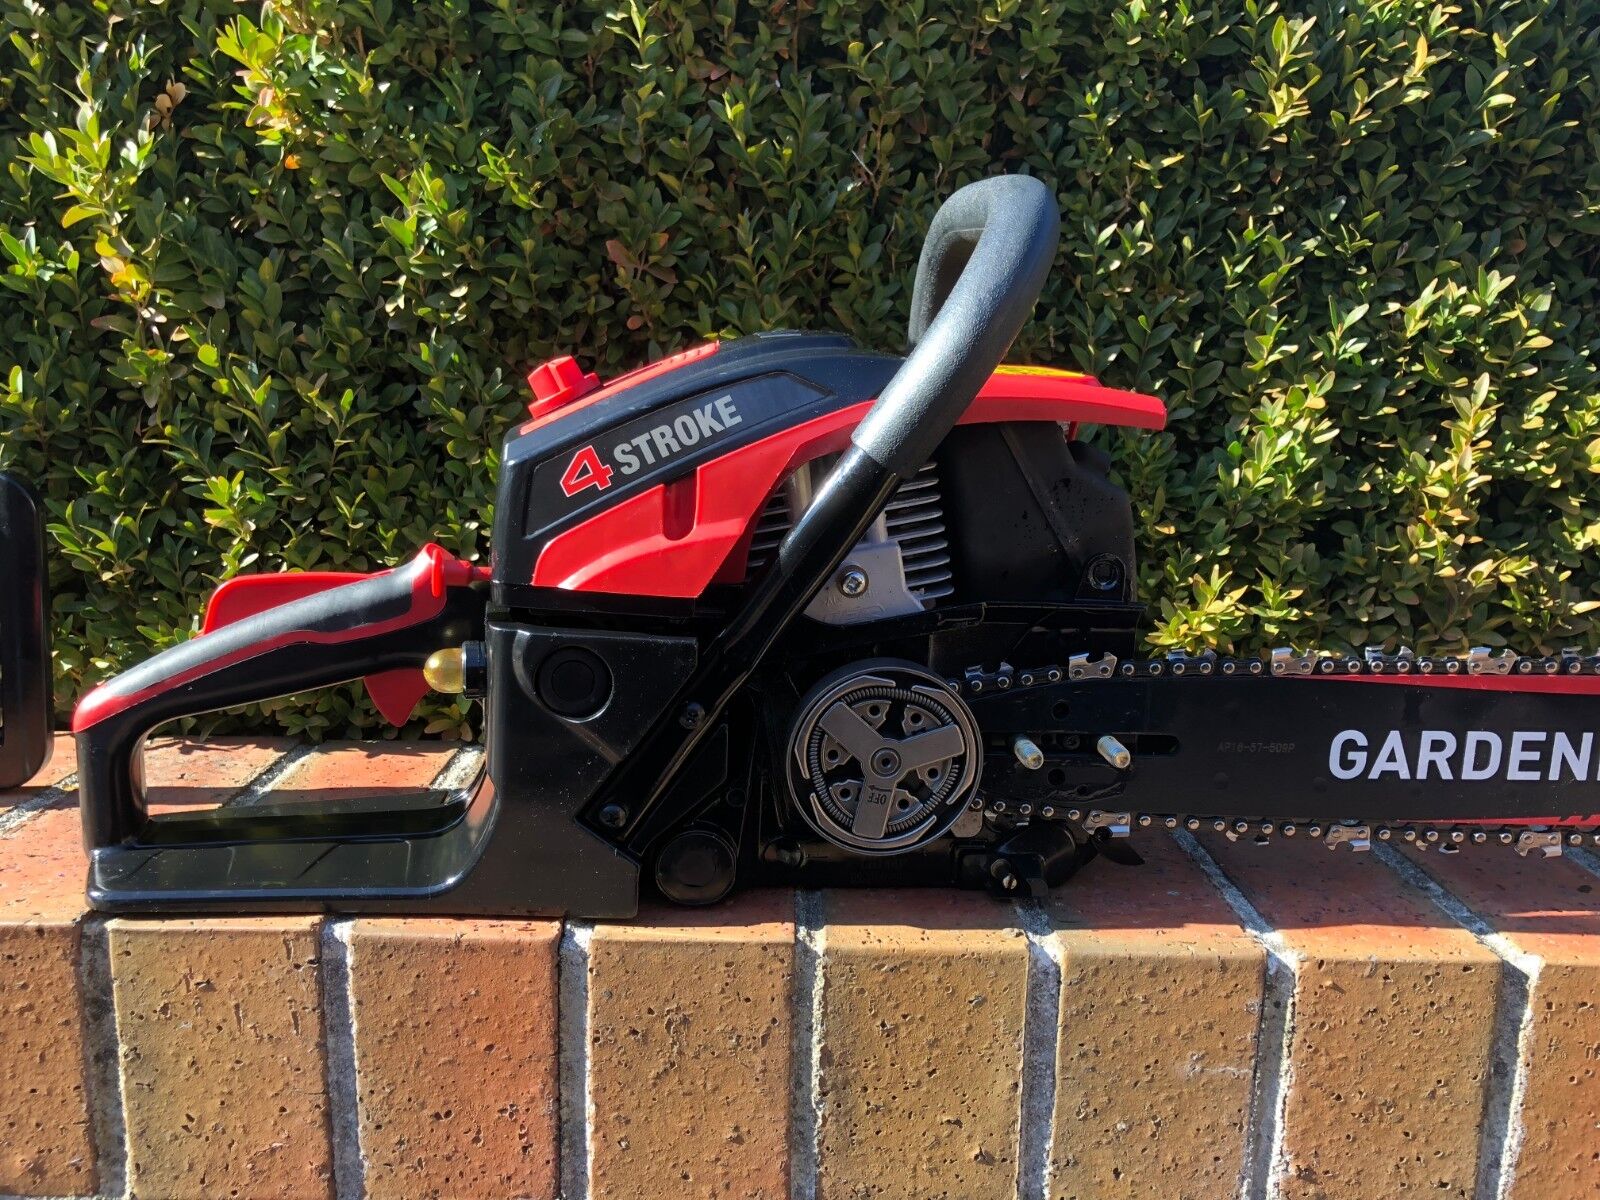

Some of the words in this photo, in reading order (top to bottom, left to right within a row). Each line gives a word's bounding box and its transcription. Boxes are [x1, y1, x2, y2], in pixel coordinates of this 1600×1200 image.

[559, 444, 614, 498] 4
[613, 394, 742, 476] STROKE
[1328, 729, 1600, 781] GARDEN
[867, 792, 887, 805] OFF
